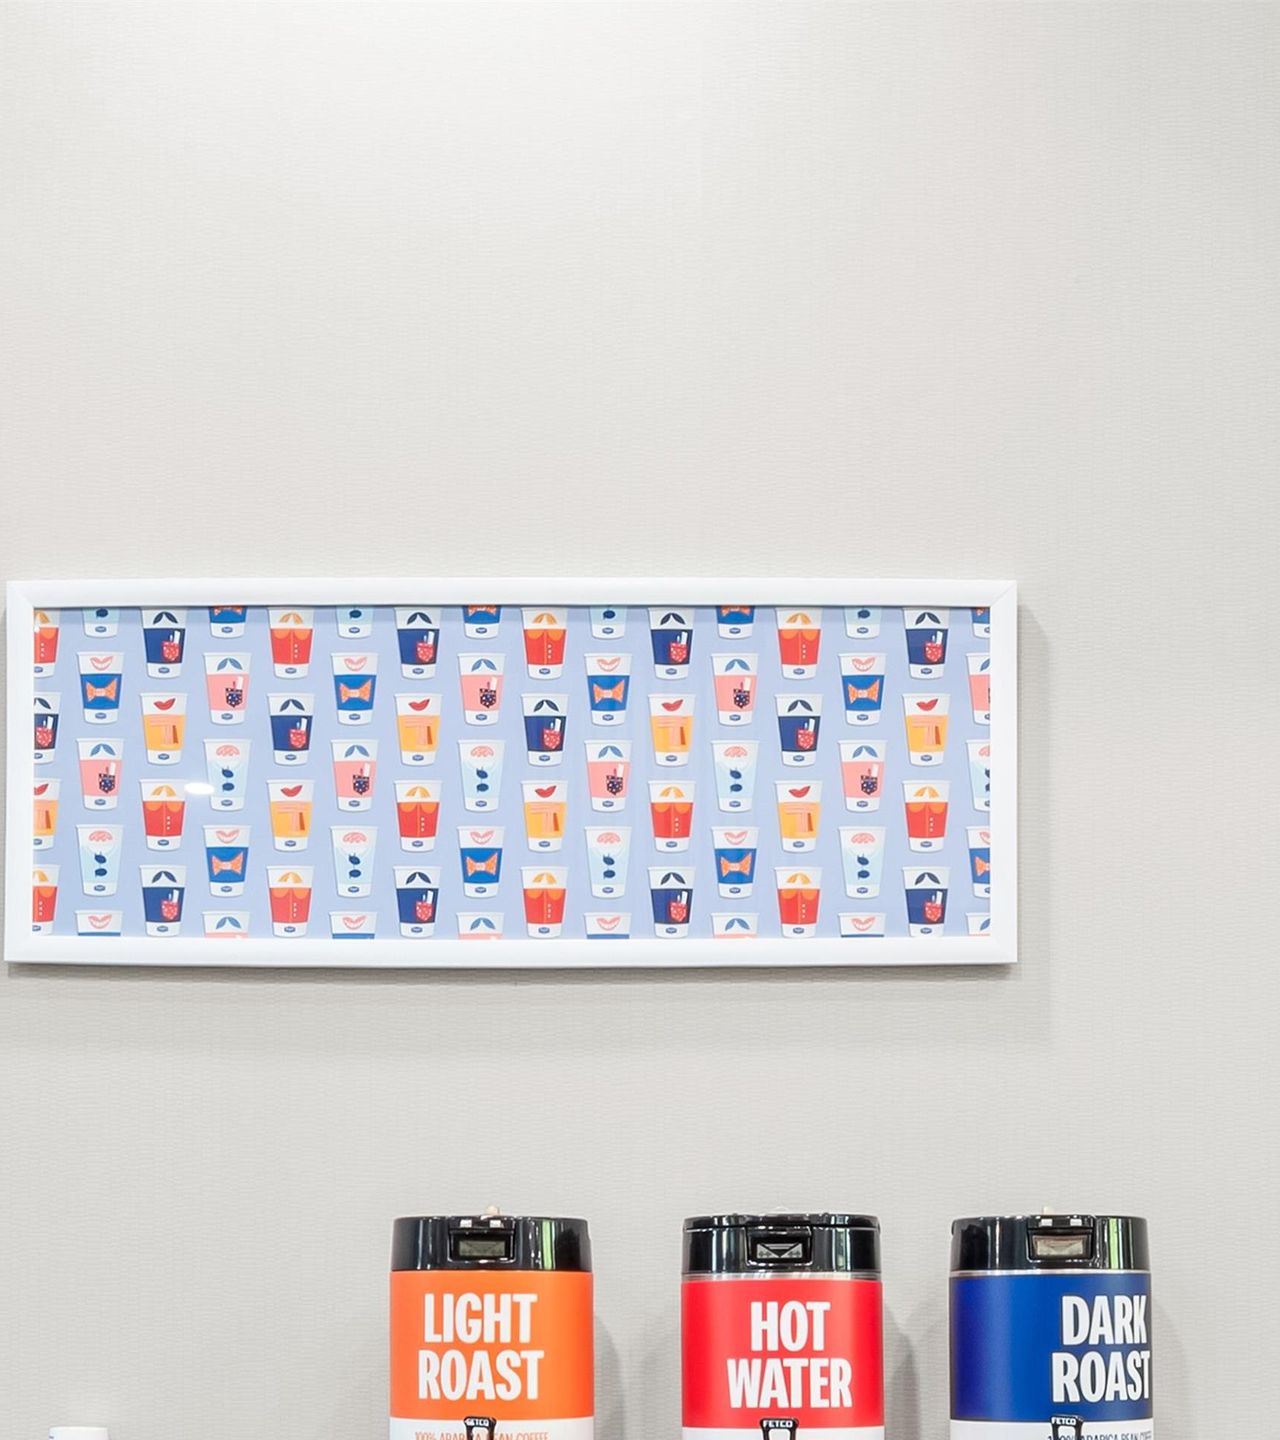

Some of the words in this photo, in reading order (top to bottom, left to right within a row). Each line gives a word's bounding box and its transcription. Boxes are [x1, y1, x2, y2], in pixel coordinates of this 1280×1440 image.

[424, 1293, 538, 1344] LIGHT
[750, 1301, 831, 1351] HOT
[1062, 1295, 1147, 1346] DARK
[417, 1349, 545, 1401] ROAST
[726, 1358, 853, 1408] WATER
[1051, 1350, 1150, 1403] ROAST
[763, 1420, 793, 1428] FETCO
[1051, 1416, 1077, 1425] FETCO
